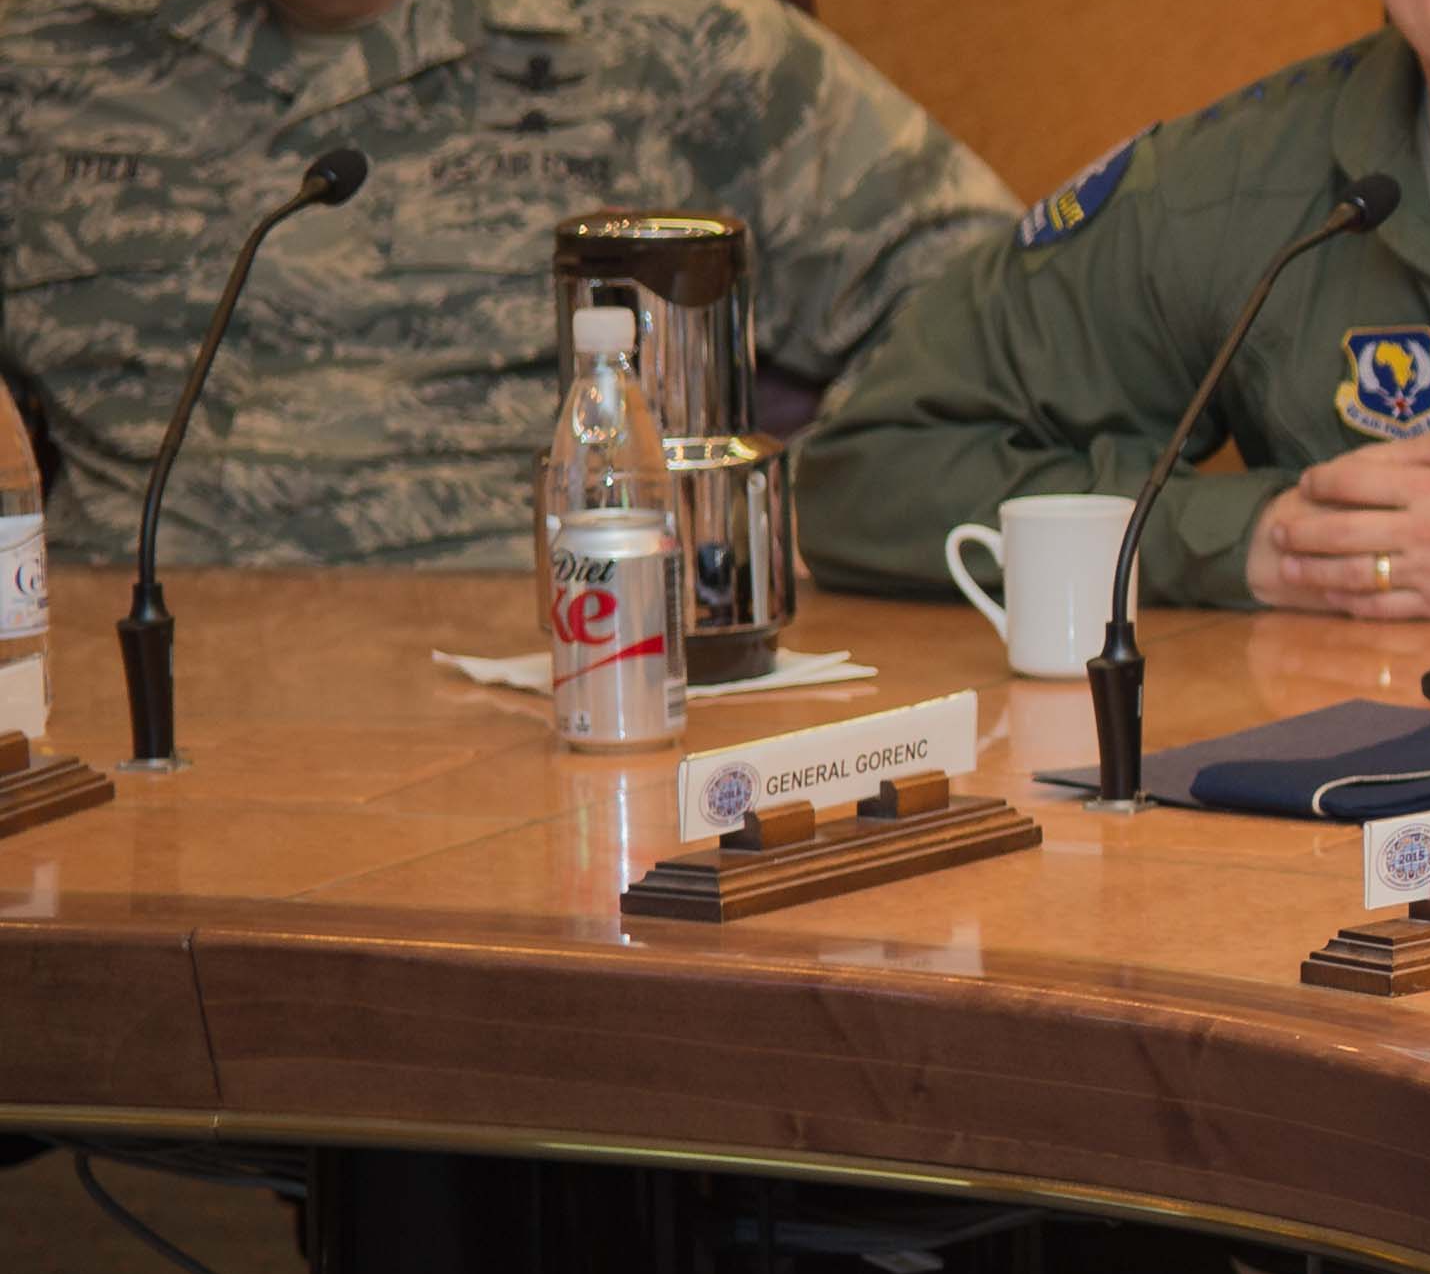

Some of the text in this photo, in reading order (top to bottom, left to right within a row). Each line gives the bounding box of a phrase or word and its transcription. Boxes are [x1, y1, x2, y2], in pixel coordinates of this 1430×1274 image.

[766, 739, 928, 796] GENERAL GORENC
[1399, 850, 1425, 865] 2015
